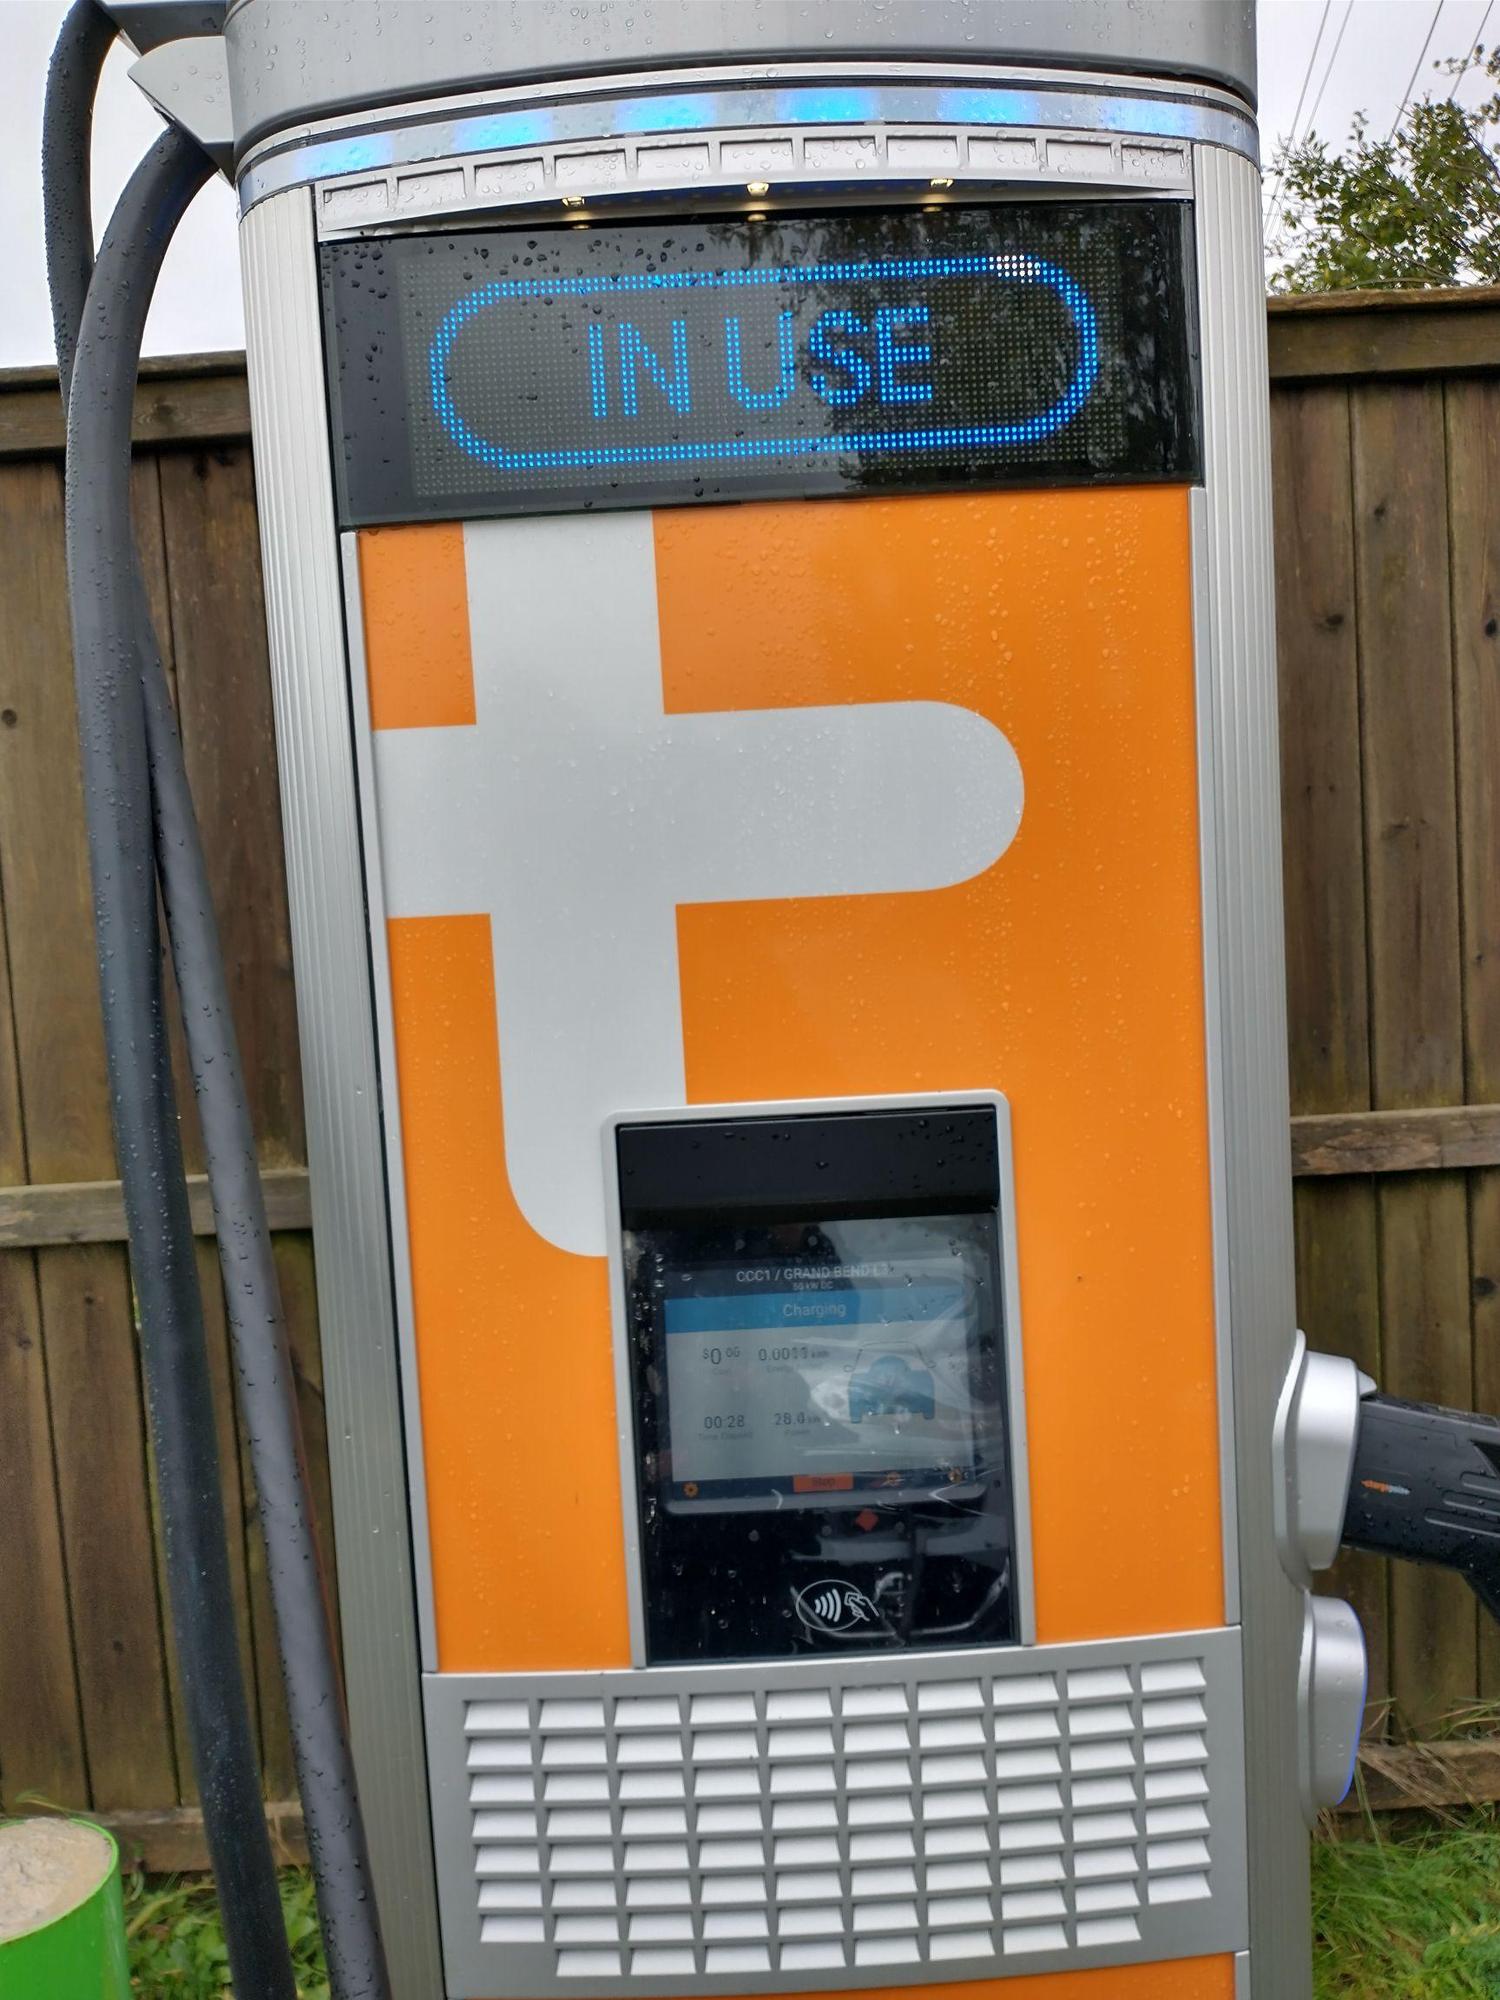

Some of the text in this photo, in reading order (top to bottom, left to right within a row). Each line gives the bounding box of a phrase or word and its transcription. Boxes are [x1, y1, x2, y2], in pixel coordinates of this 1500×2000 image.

[589, 306, 933, 418] IN USE
[735, 1269, 771, 1283] CCC1
[774, 1267, 782, 1281] /
[783, 1265, 831, 1280] GRAND
[832, 1263, 870, 1278] BEND
[782, 1302, 847, 1318] Charging
